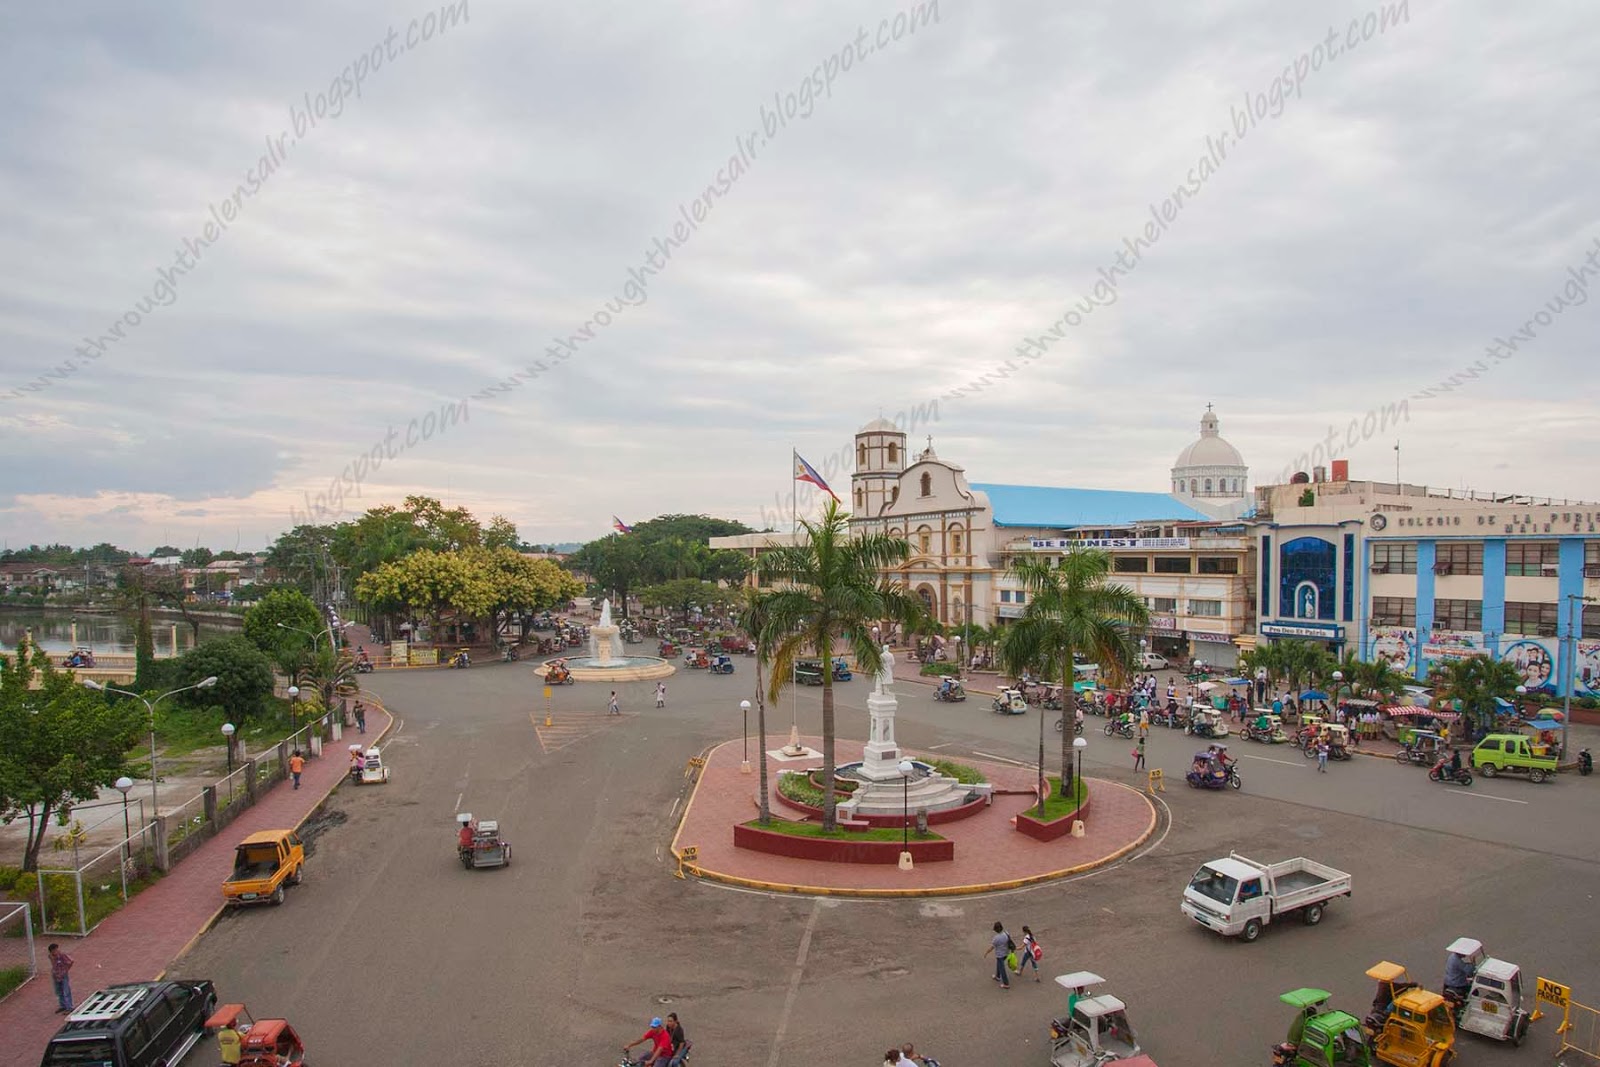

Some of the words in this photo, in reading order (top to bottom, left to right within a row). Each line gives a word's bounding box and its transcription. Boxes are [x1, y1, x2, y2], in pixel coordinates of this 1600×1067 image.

[1398, 516, 1460, 527] COLEGIO
[1477, 515, 1496, 526] DE
[1513, 513, 1531, 524] LA
[1505, 522, 1551, 533] MAIN
[1033, 540, 1054, 548] BE
[684, 847, 696, 855] NO
[1543, 982, 1562, 996] NO
[1537, 989, 1567, 1007] PARKING
